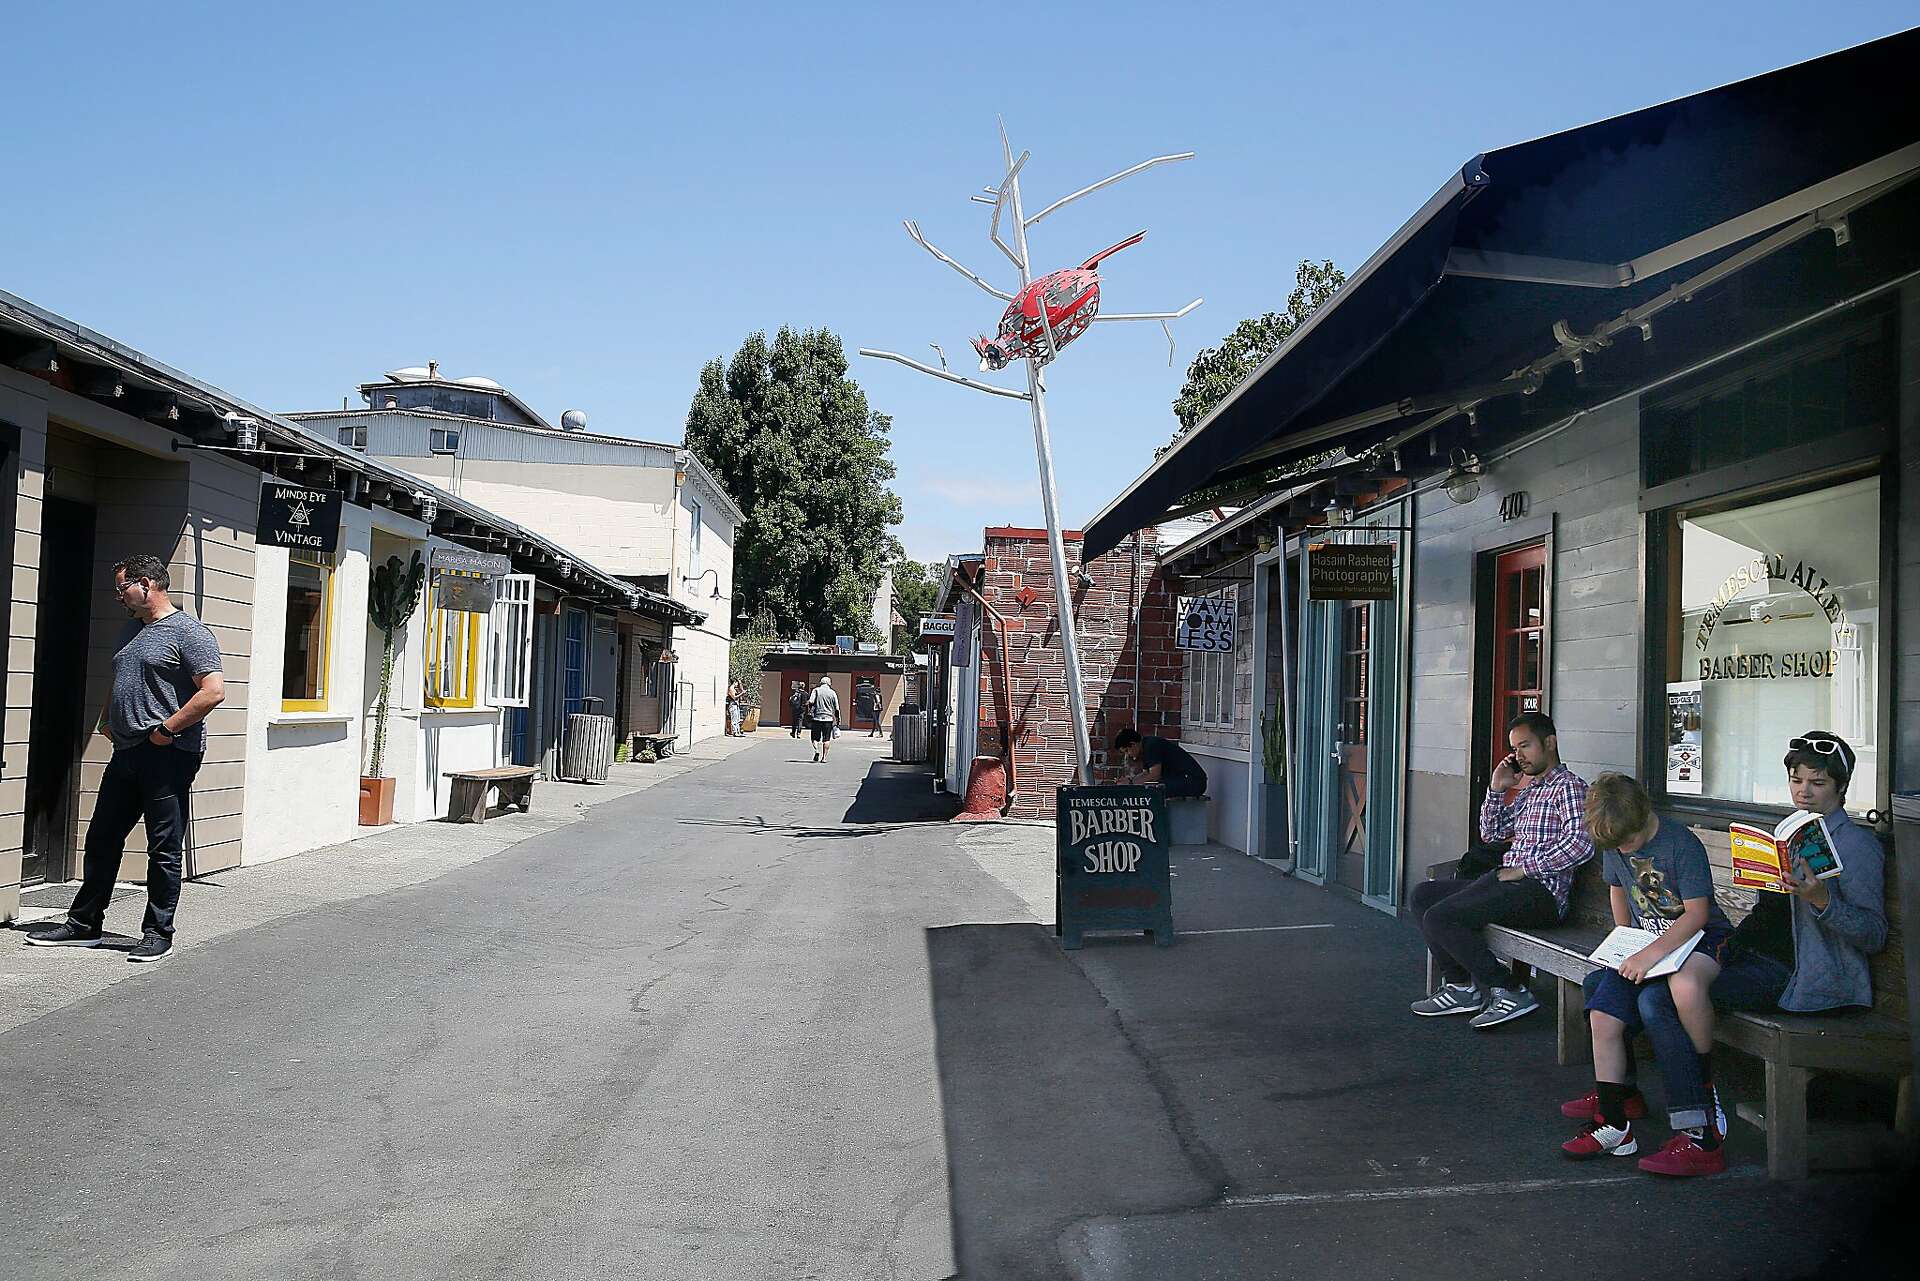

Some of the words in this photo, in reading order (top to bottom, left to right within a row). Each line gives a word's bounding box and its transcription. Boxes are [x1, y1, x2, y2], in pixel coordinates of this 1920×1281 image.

[275, 487, 308, 501] MINDS
[308, 491, 327, 503] EYE
[274, 529, 323, 547] VINTAGE
[470, 559, 501, 569] MASON
[1312, 552, 1346, 566] Hasain
[1348, 553, 1390, 567] Rasheed
[1312, 568, 1390, 585] Photography
[1179, 598, 1235, 616] WAVE
[1696, 553, 1788, 652] TEMESCAL
[923, 622, 956, 632] BAGGU
[1178, 613, 1233, 632] FORM
[1176, 629, 1233, 650] LESS
[1699, 652, 1777, 682] BARBER
[1781, 650, 1841, 678] SHOP
[1069, 797, 1119, 808] TEMESCAL
[1122, 797, 1152, 807] ALLEY
[1069, 808, 1157, 846] BARBER
[1083, 840, 1142, 873] SHOP
